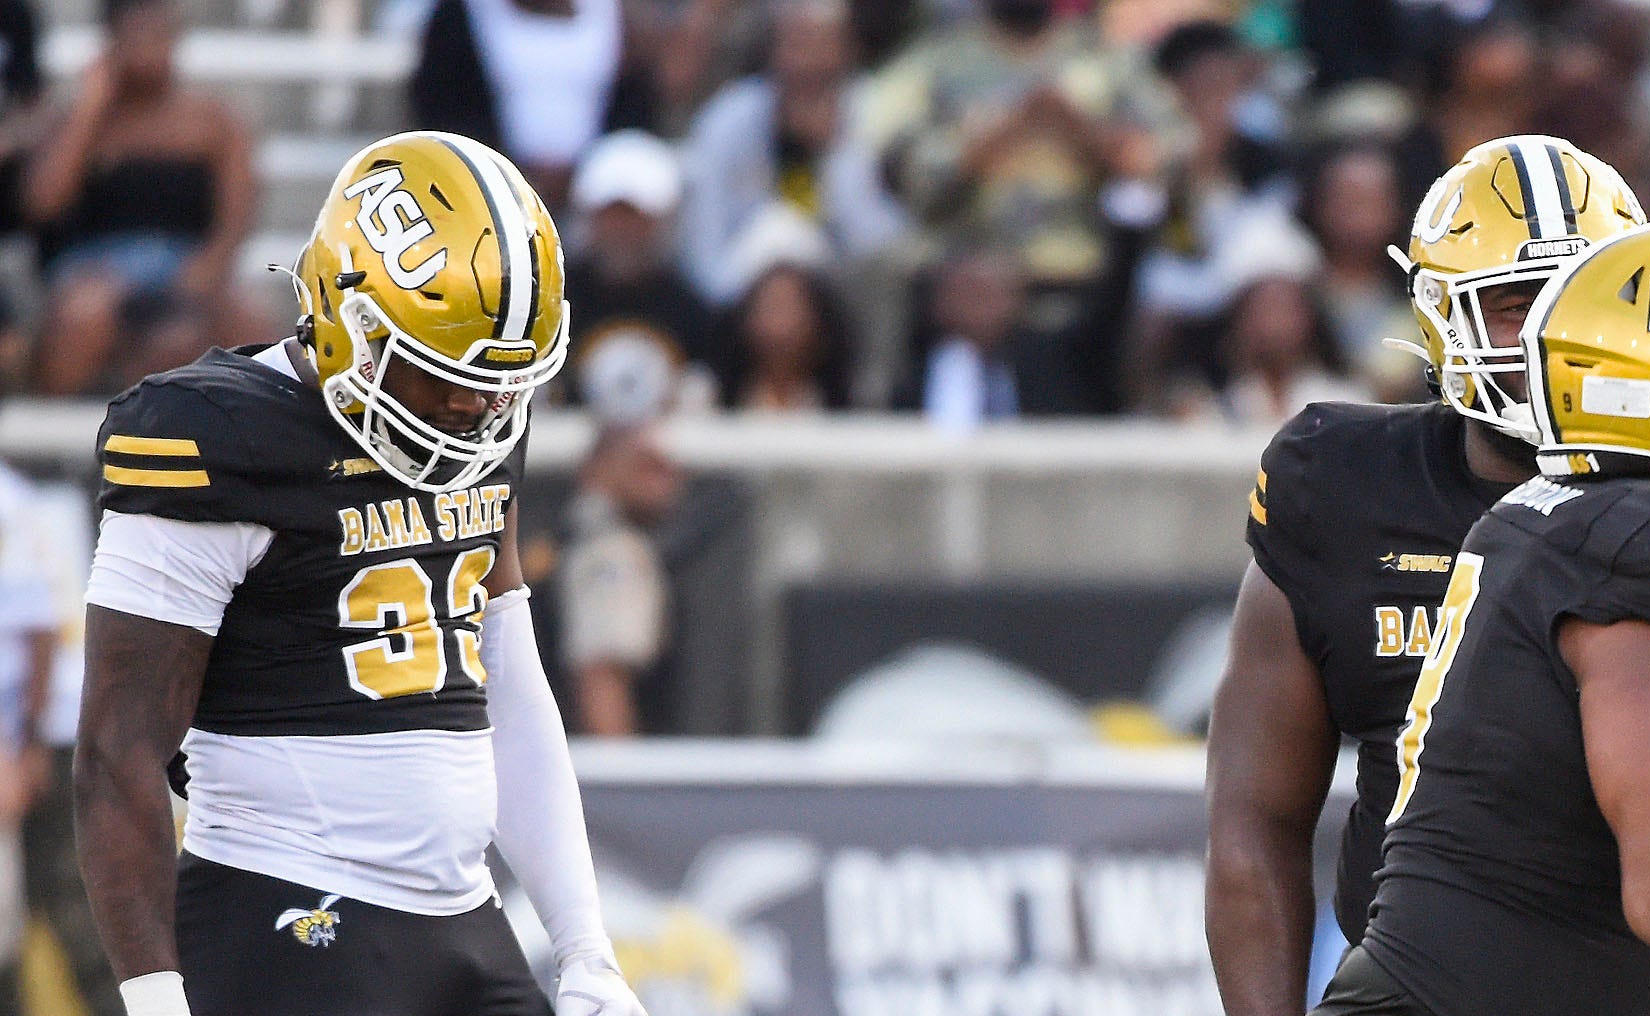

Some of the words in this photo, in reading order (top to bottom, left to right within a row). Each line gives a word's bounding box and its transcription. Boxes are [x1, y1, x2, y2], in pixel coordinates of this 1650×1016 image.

[343, 166, 449, 291] ASU
[1562, 392, 1573, 413] 9
[338, 497, 433, 556] BAMA
[435, 484, 510, 541] STATE
[1375, 605, 1446, 657] BA
